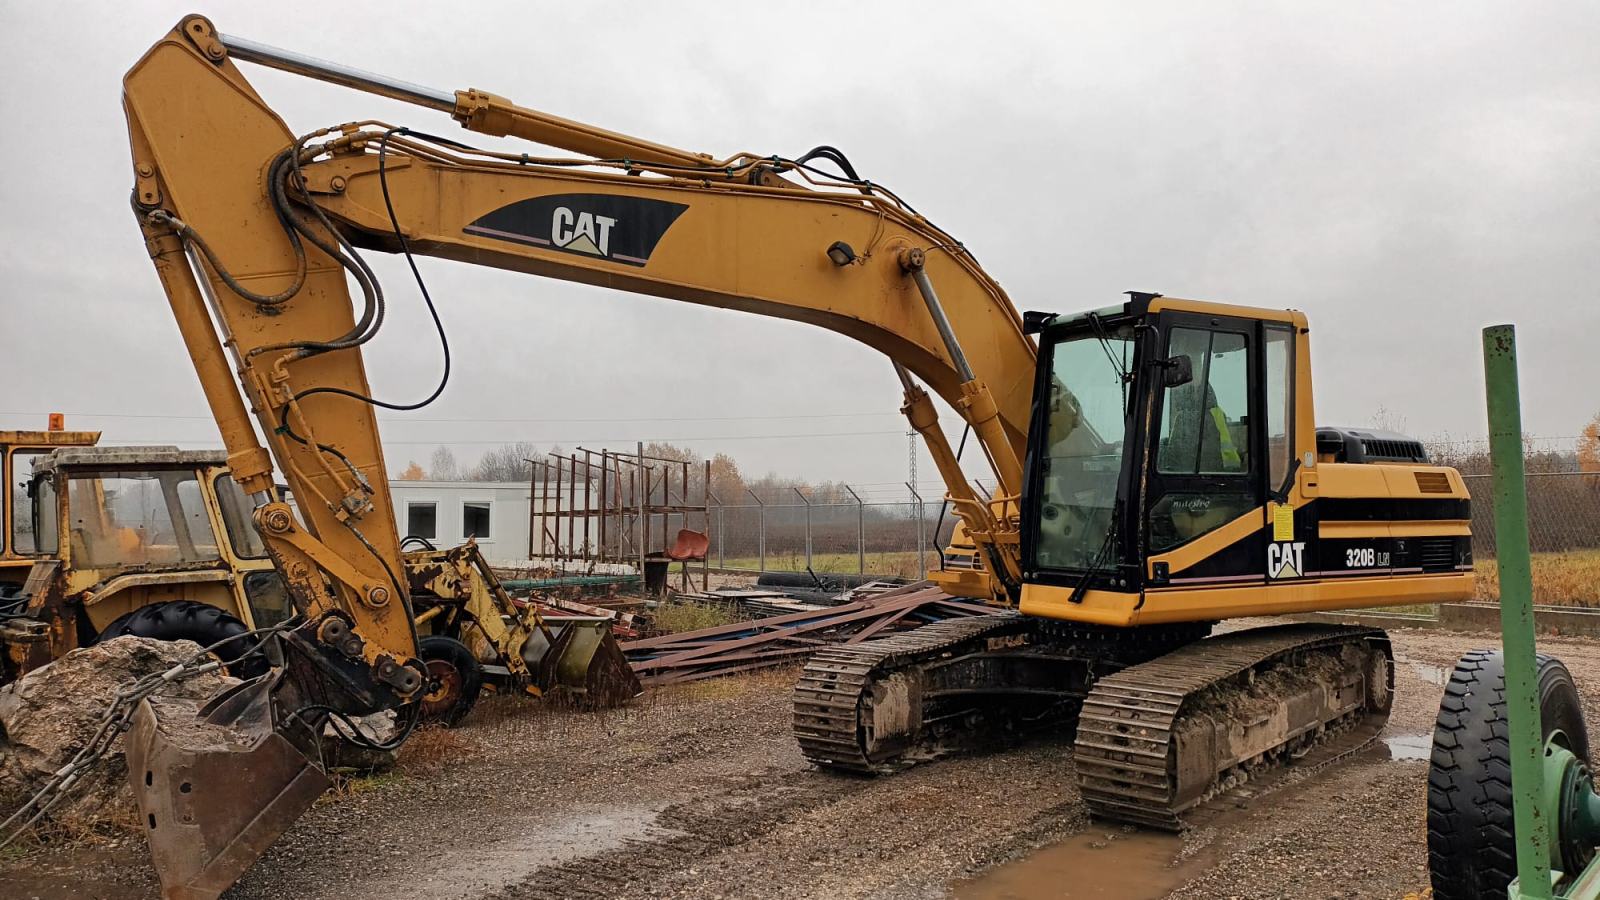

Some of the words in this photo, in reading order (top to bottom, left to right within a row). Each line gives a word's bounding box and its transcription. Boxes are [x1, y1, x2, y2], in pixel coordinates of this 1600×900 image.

[551, 206, 615, 256] CAT
[1267, 542, 1305, 578] CAT
[1346, 548, 1375, 567] 320B
